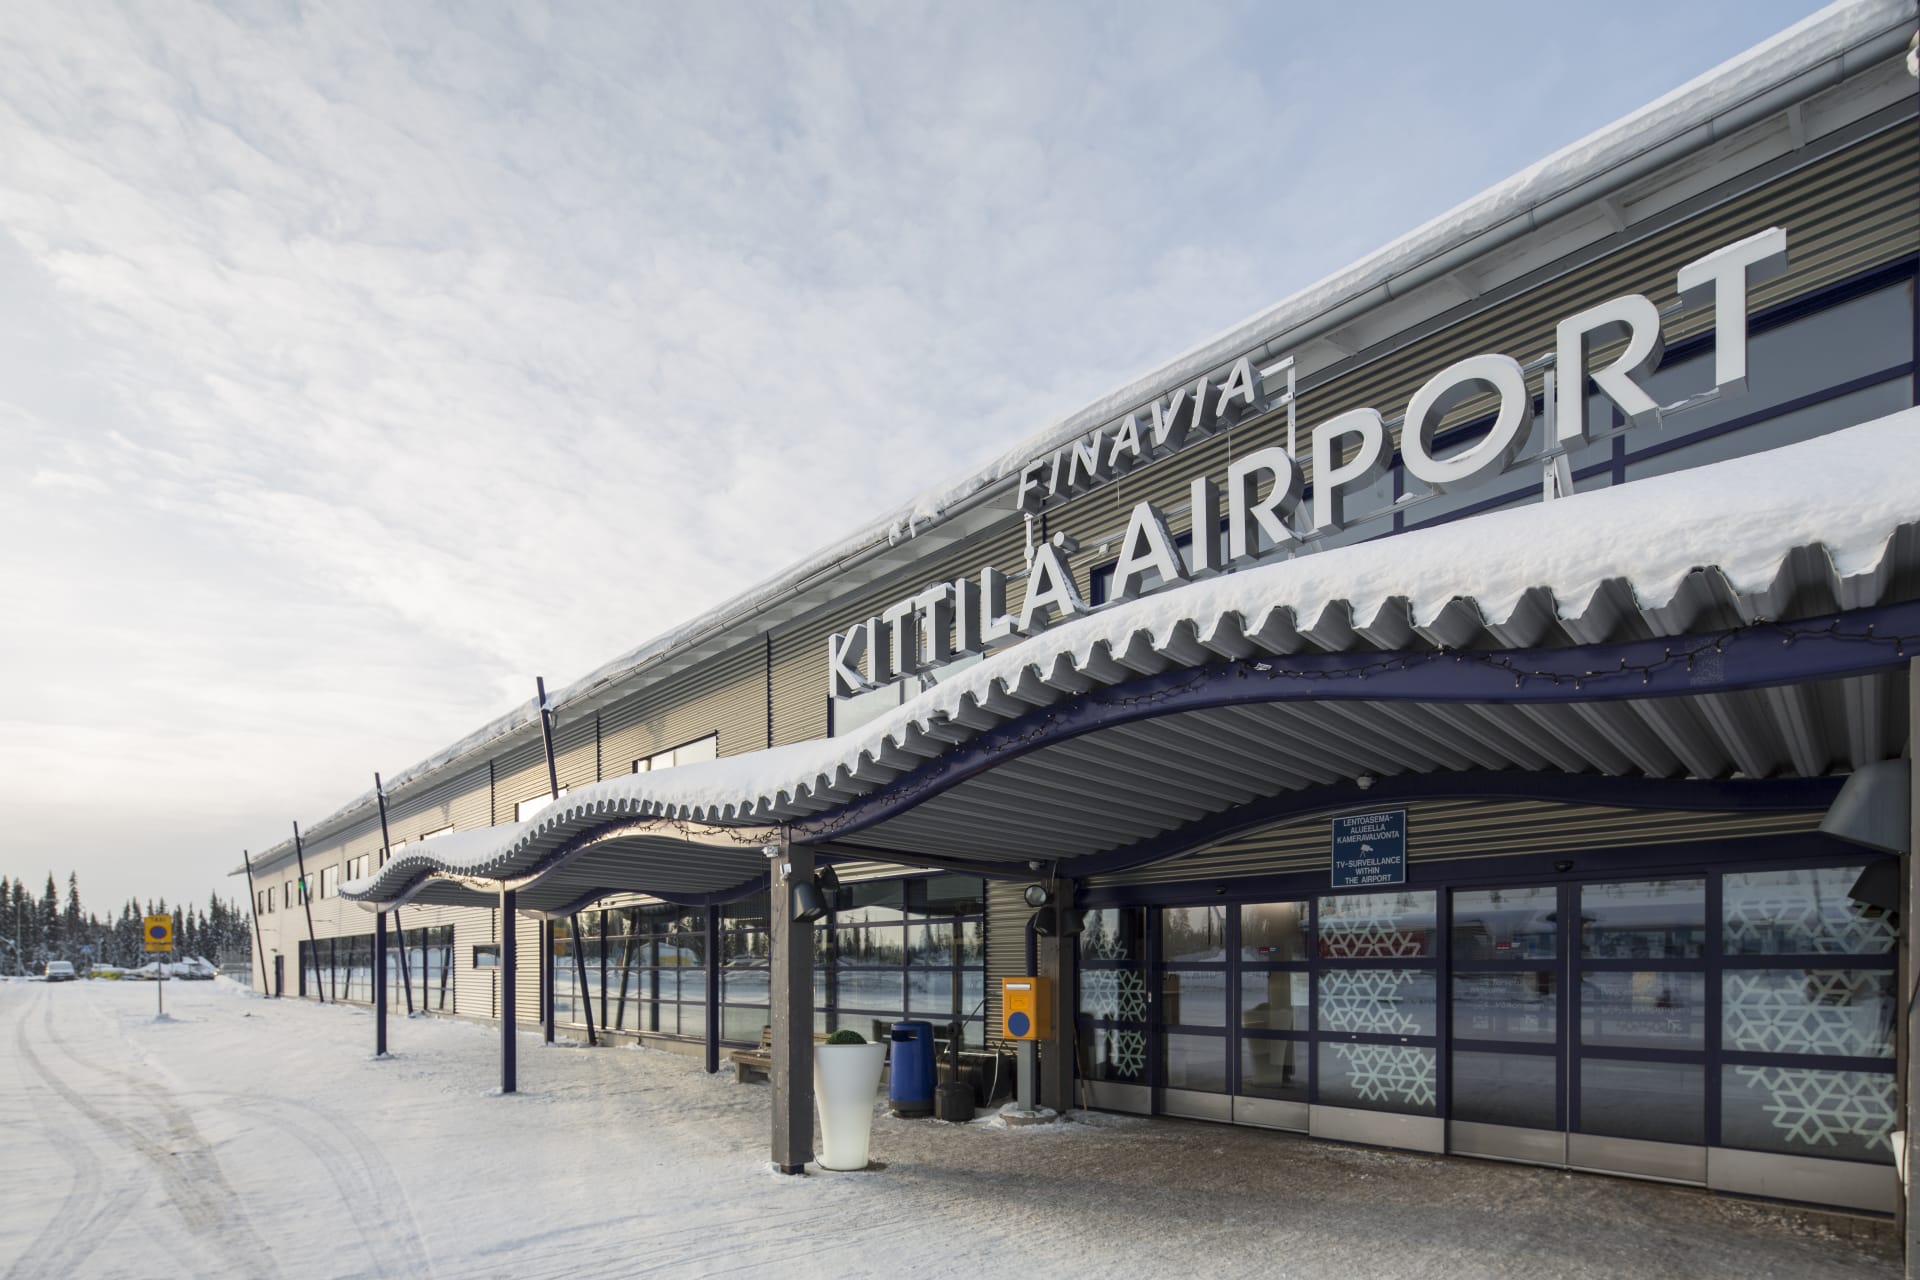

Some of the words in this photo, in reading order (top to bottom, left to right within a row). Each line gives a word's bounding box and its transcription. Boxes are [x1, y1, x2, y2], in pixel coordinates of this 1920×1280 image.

[1016, 356, 1260, 512] FINAVIA
[827, 530, 1084, 699] KITTILÄ
[1110, 226, 1787, 602] AIRPORT
[1343, 814, 1394, 827] LENTOASEMA-
[1350, 823, 1386, 834] ALUEELLA
[1336, 830, 1400, 844] KAMERAVALVONTA
[1335, 856, 1401, 869] TV-SURVEILLANCE
[1355, 866, 1380, 876] WITHIN
[1344, 876, 1359, 885] THE
[1361, 874, 1392, 883] AIRPORT
